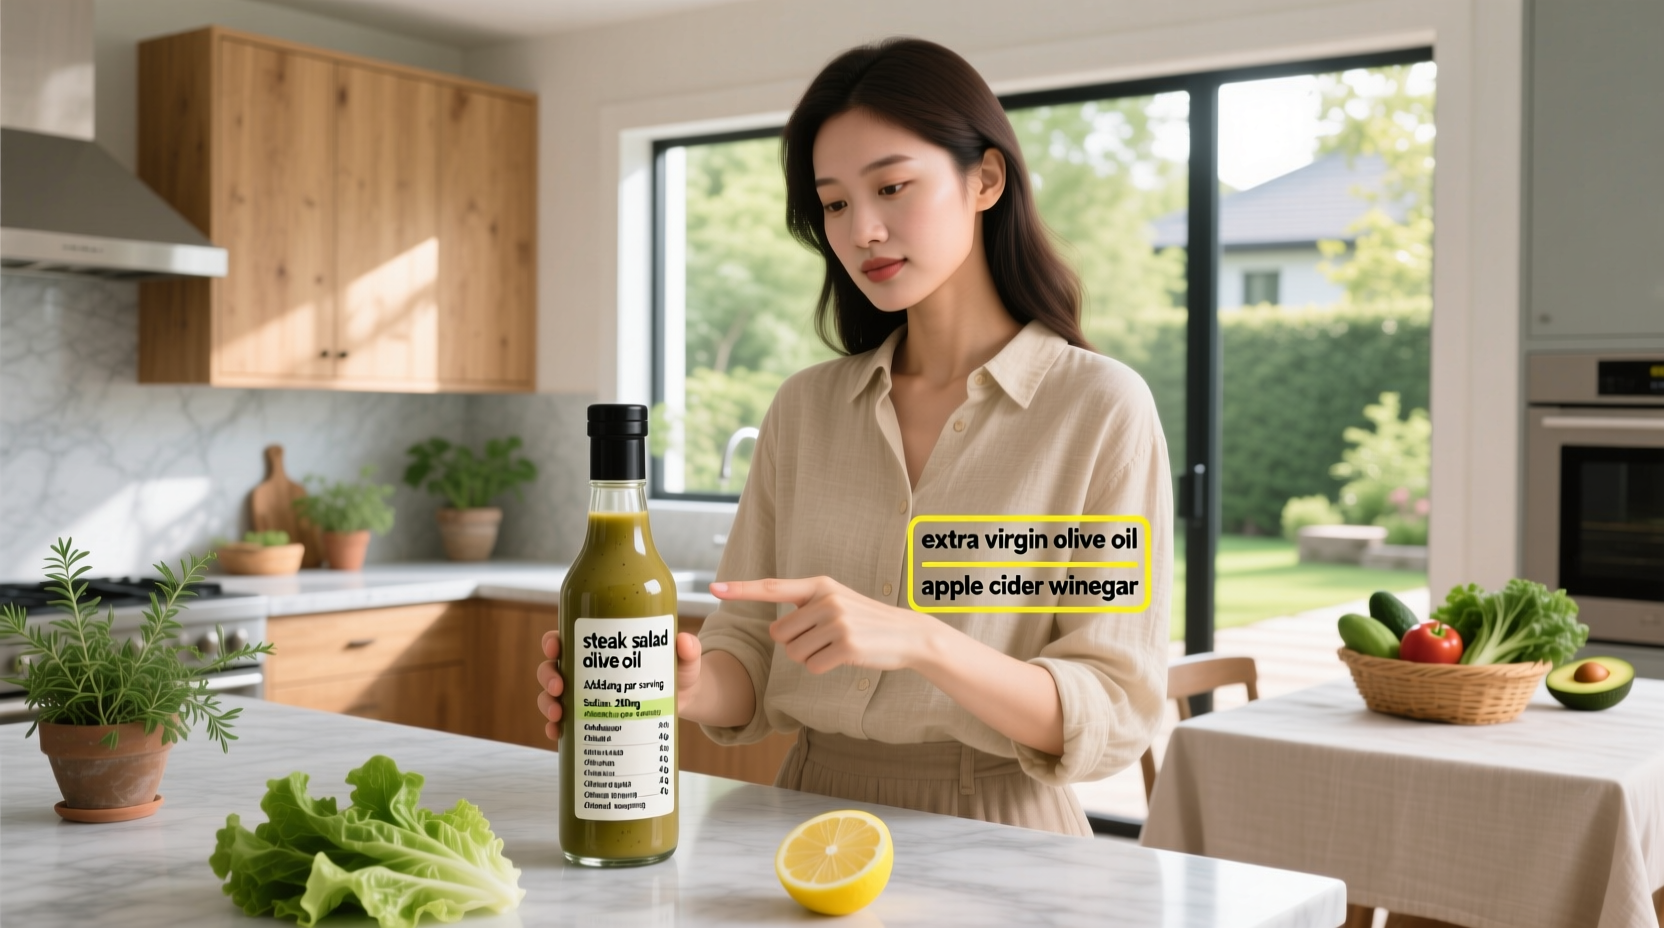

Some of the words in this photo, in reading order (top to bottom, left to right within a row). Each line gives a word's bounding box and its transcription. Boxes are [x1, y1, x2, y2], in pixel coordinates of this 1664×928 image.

[583, 631, 627, 649] steak
[632, 628, 668, 649] salad
[582, 651, 619, 669] olive
[622, 650, 641, 669] oil
